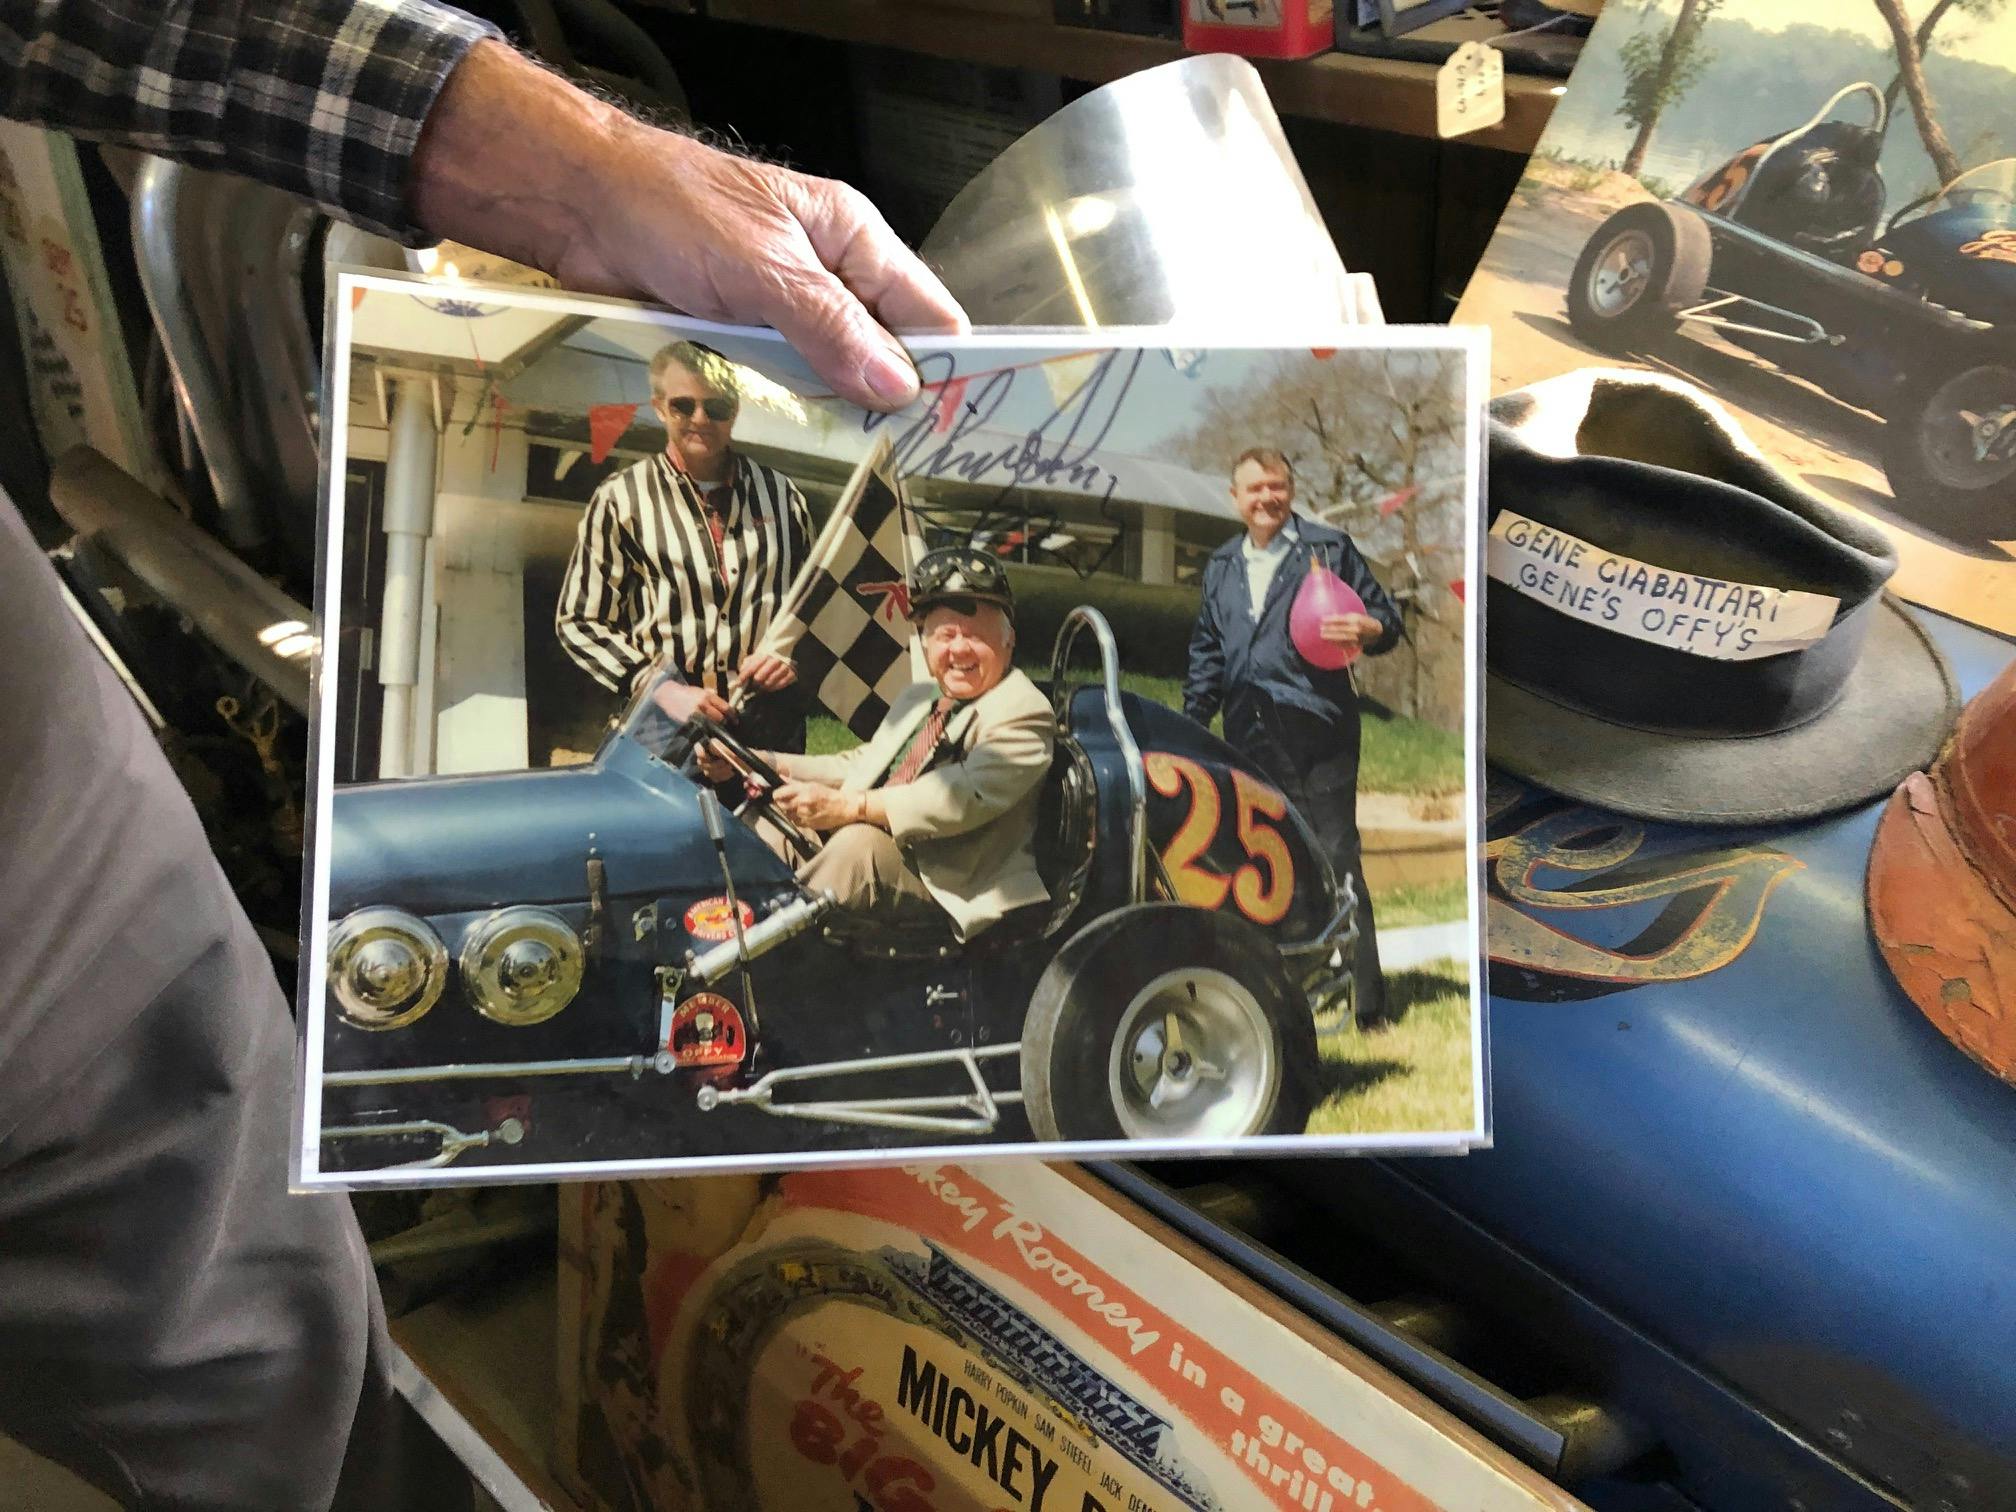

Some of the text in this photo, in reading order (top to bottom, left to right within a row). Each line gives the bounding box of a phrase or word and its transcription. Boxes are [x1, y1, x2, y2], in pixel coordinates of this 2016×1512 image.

[1504, 519, 1589, 569] GENE
[1519, 563, 1758, 652] GENE'S OFFY'S
[1141, 752, 1296, 926] 25
[897, 1343, 1059, 1512] MICKEY
[992, 1203, 1161, 1356] Rooney
[1168, 1341, 1208, 1389] in
[1219, 1386, 1246, 1417] a
[1257, 1414, 1375, 1509] great
[963, 1359, 993, 1391] HARRY
[995, 1382, 1028, 1420] POPKIN
[1034, 1413, 1056, 1442] SAM
[1059, 1435, 1093, 1476] STIEFEL
[1099, 1471, 1123, 1502] JACK
[1231, 1428, 1335, 1512] thrill
